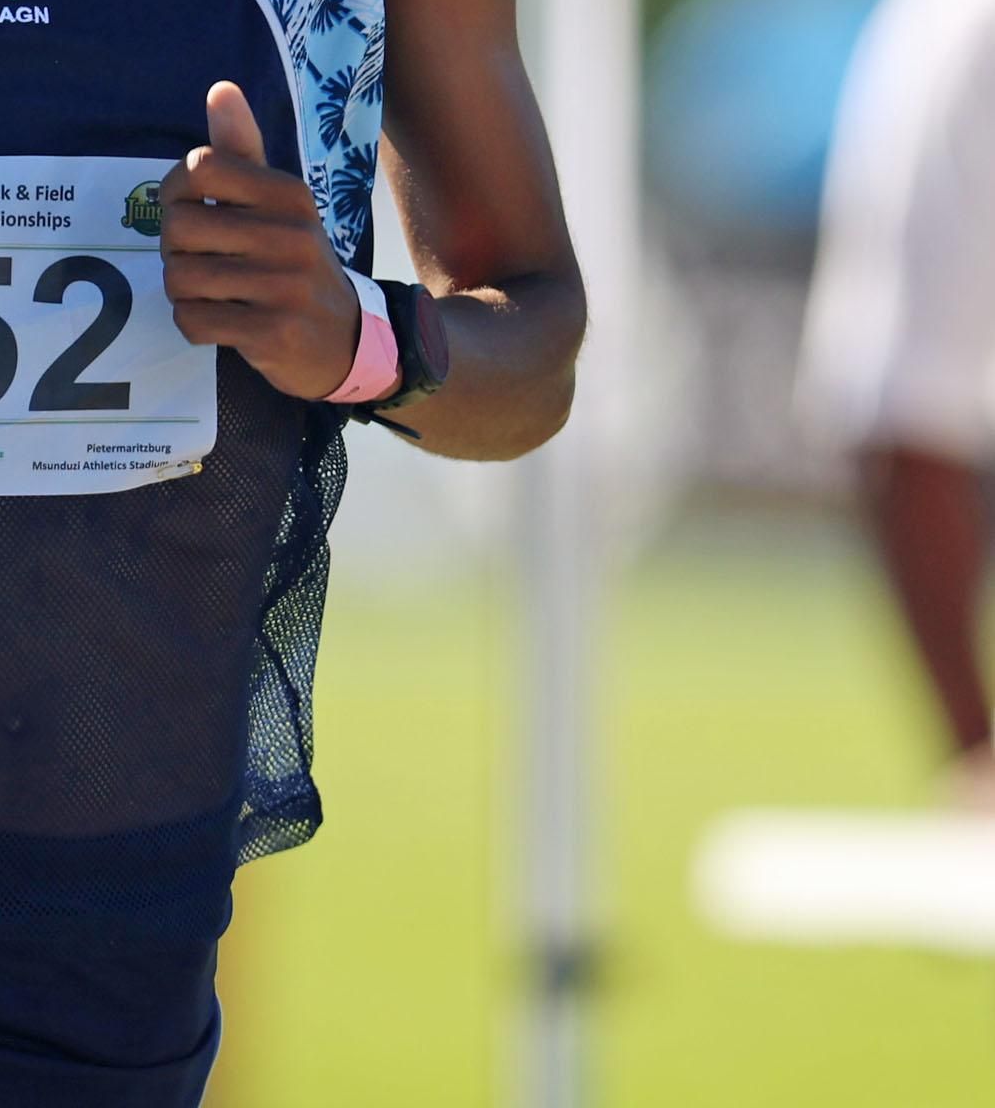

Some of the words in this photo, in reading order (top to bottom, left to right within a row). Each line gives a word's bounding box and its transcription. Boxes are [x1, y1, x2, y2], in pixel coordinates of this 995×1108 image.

[16, 184, 30, 201] &
[35, 185, 75, 201] Field
[121, 197, 163, 228] Jung
[86, 443, 172, 454] Pietermaritzburg
[32, 460, 80, 471] Msunduzi
[82, 460, 127, 470] Athletics
